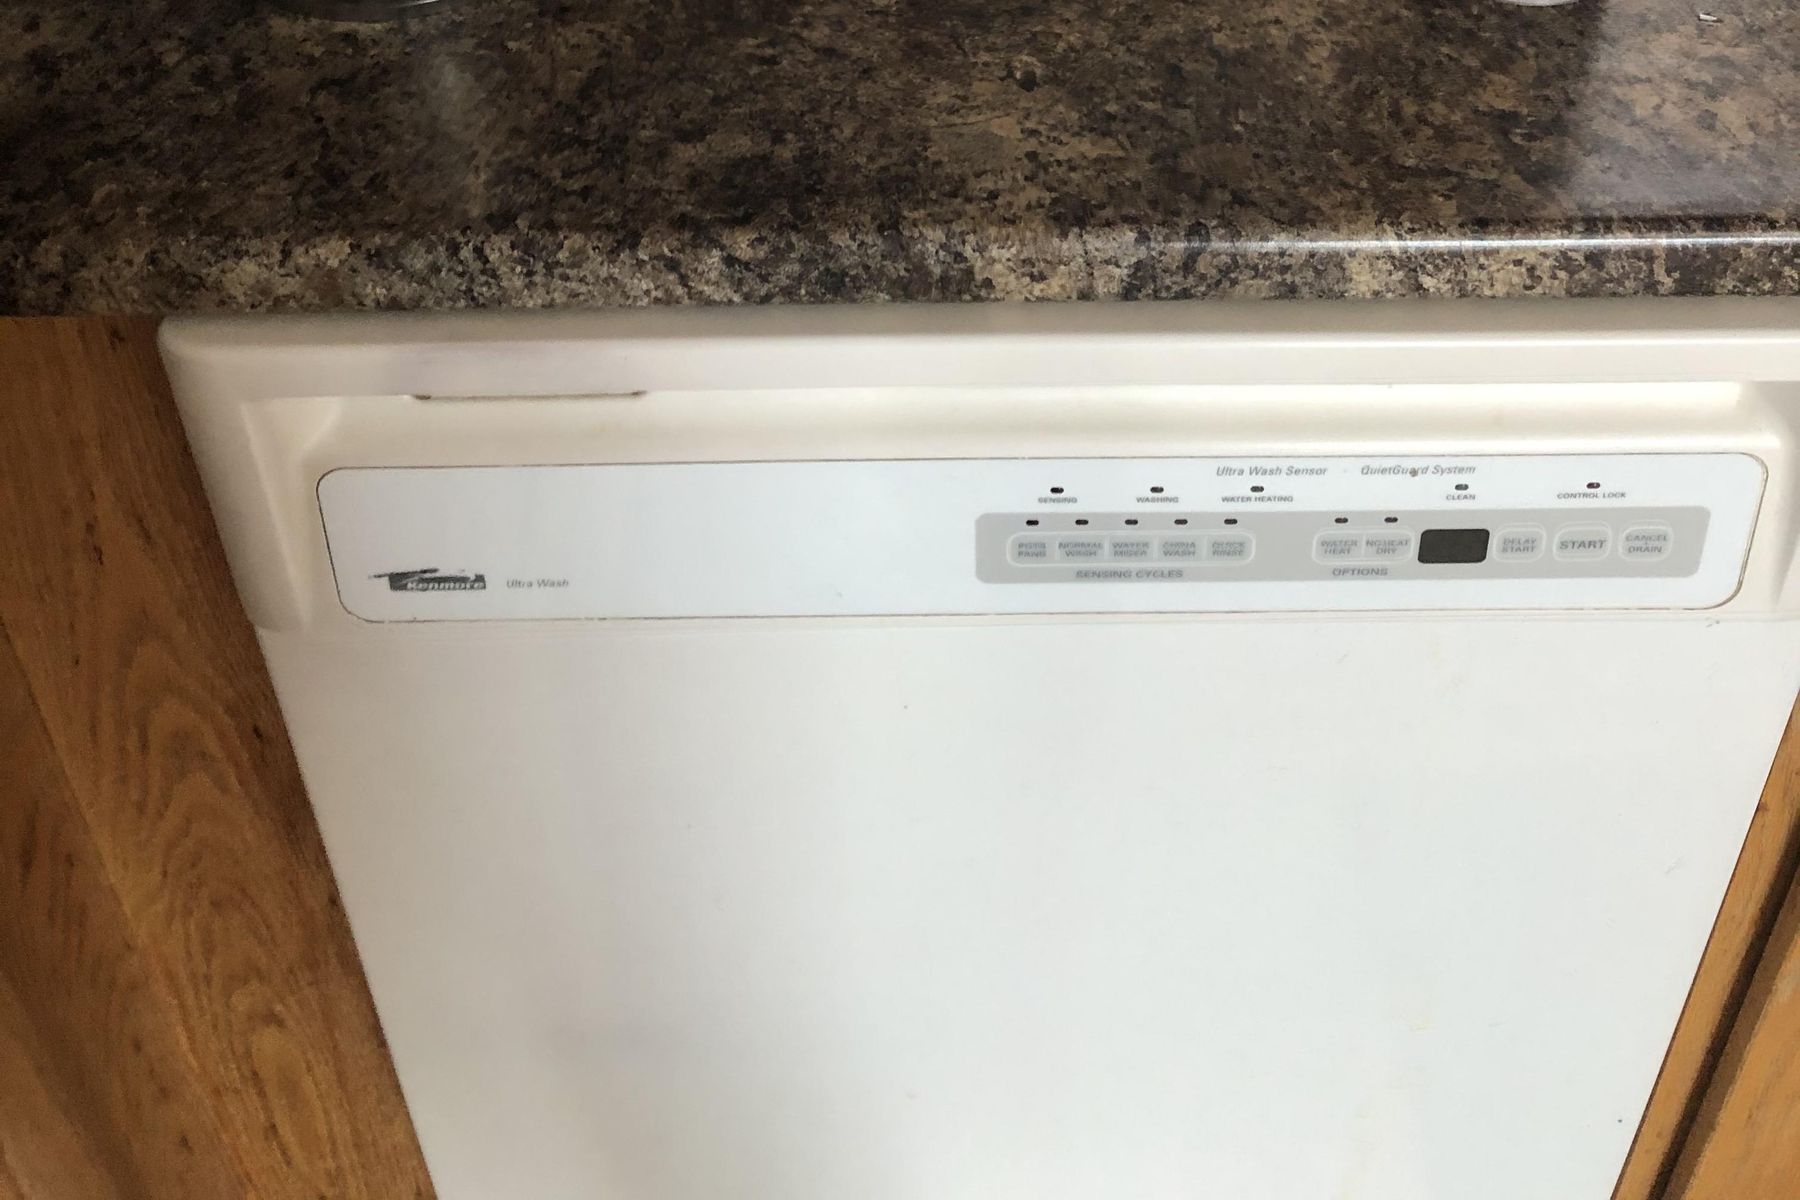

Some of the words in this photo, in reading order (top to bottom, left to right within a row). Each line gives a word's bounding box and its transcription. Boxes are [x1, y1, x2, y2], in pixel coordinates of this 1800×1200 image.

[1216, 466, 1244, 477] Ultra
[1249, 465, 1282, 476] Wash
[1285, 465, 1328, 476] Sensor
[1361, 464, 1428, 477] QuietGuard
[1431, 464, 1477, 477] System
[1037, 496, 1078, 504] SENSING
[1136, 496, 1179, 504] WASHING
[1221, 495, 1252, 503] WATER
[1254, 495, 1294, 503] HEATING
[1446, 493, 1476, 501] CLEAN
[1556, 491, 1600, 500] CONTROL
[1602, 491, 1627, 499] LOCK
[1502, 537, 1538, 546] DELAY
[1625, 534, 1669, 543] CANCEL
[1559, 539, 1607, 550] START
[1500, 545, 1537, 554] START
[1627, 545, 1664, 554] DRAIN
[1075, 569, 1133, 579] SENSING
[1135, 569, 1184, 579] CYCLES
[1331, 567, 1389, 577] OPTIONS
[506, 579, 534, 589] Ultra
[537, 578, 570, 589] Wash
